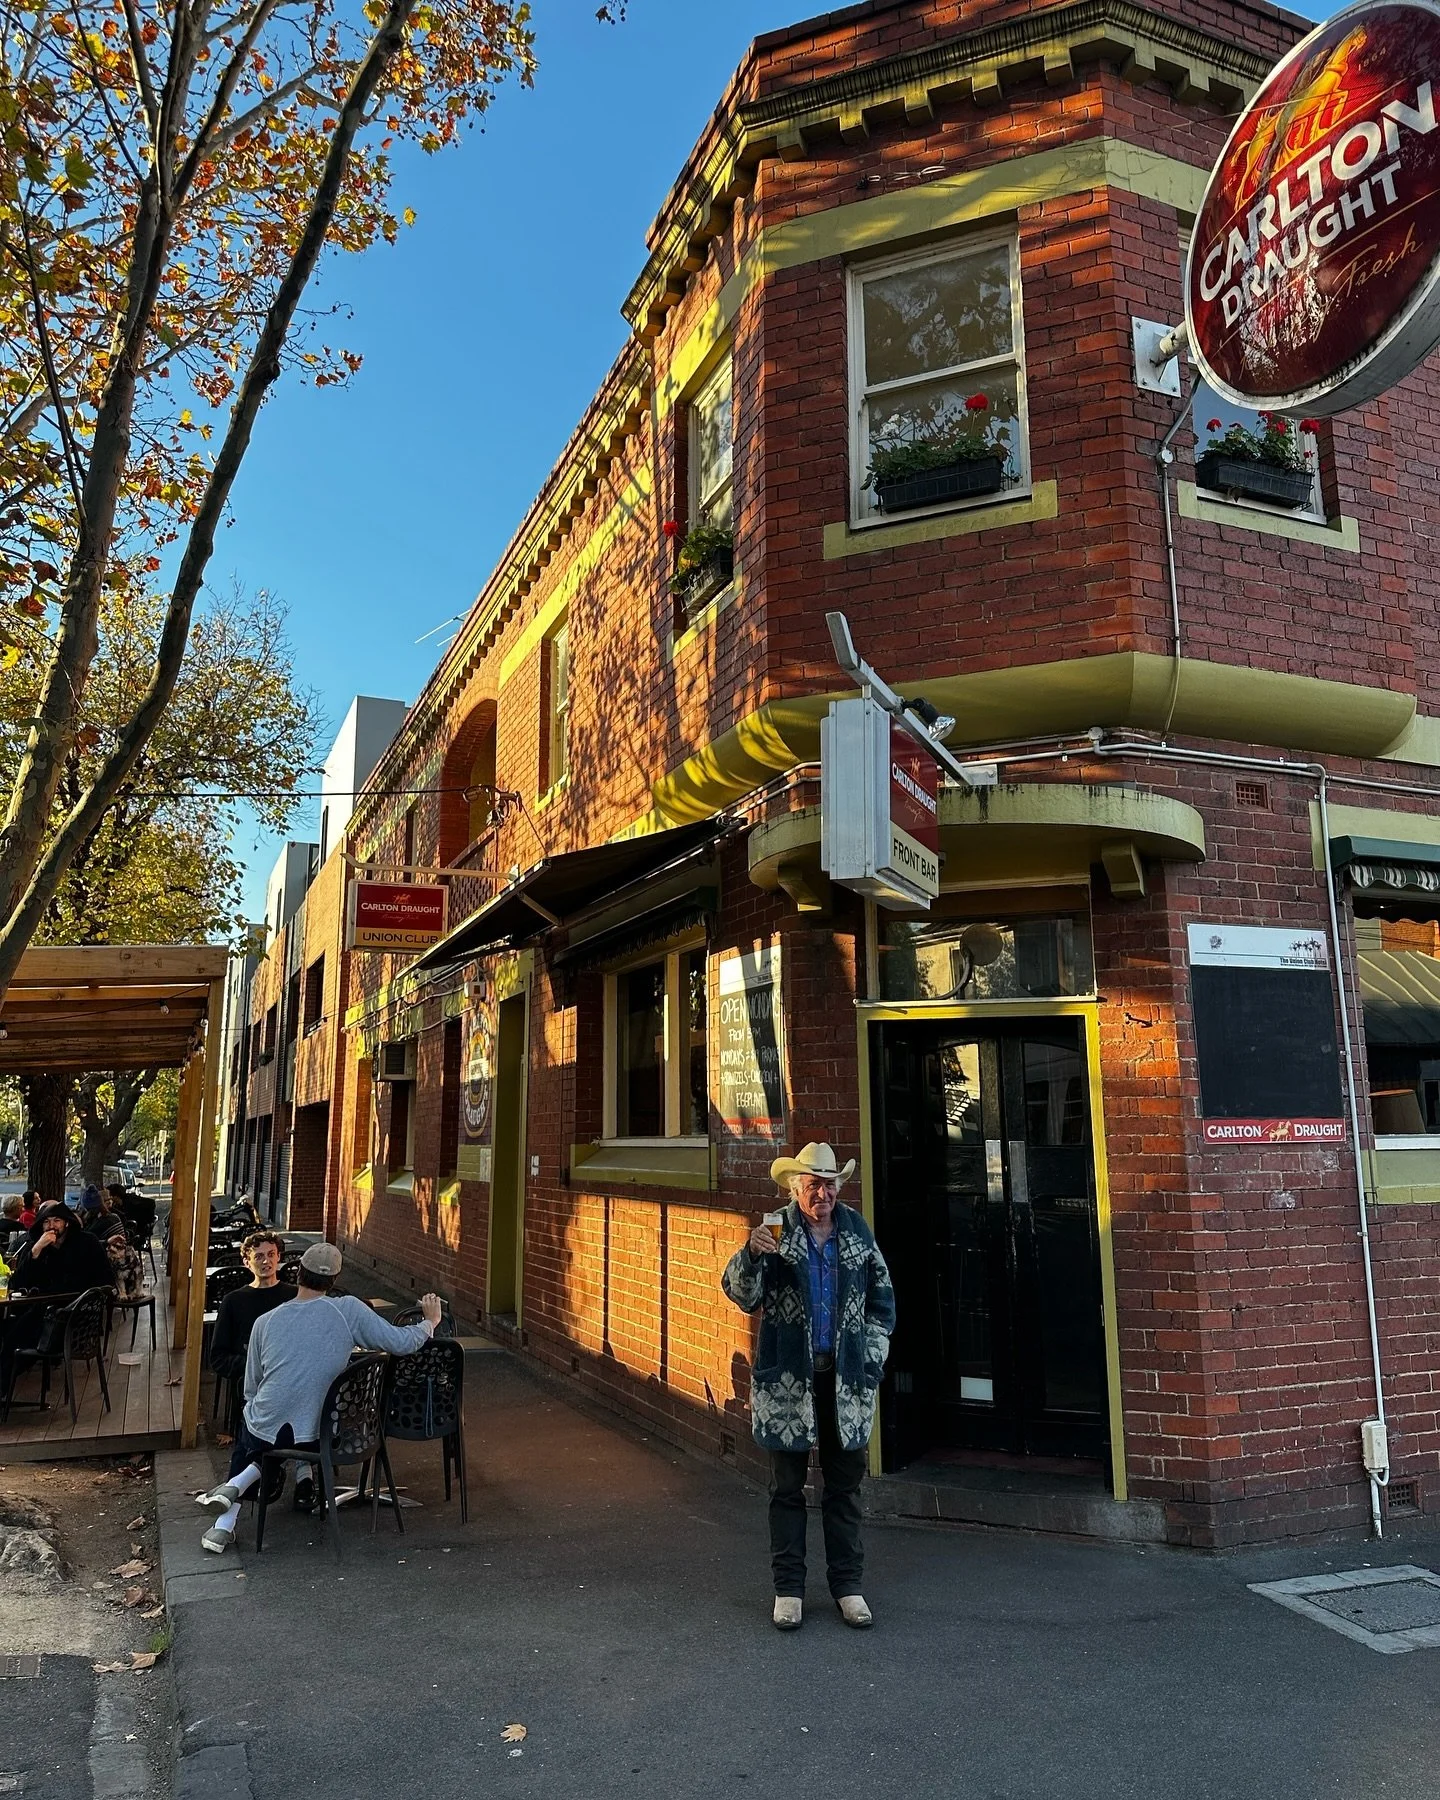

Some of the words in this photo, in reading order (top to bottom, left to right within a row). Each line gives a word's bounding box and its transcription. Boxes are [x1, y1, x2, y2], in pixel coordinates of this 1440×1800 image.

[1358, 46, 1387, 72] 1864
[1199, 80, 1439, 302] CARLTON
[1220, 160, 1402, 329] DRAUGHT
[892, 761, 915, 796] CARLTON
[914, 783, 937, 815] DRAUGHT
[893, 837, 920, 872] FRONT
[921, 857, 937, 884] BAR
[362, 903, 399, 912] CARLTON
[401, 905, 440, 914] DRAUGHT
[362, 932, 403, 943] UNION
[404, 934, 439, 944] CLUB
[720, 996, 747, 1025] OPEN
[728, 1028, 745, 1043] FROM
[722, 1123, 744, 1134] CARLTON
[756, 1123, 784, 1134] DRAUGHT
[1207, 1125, 1262, 1138] CARLTON
[1294, 1123, 1343, 1137] DRAUGHT
